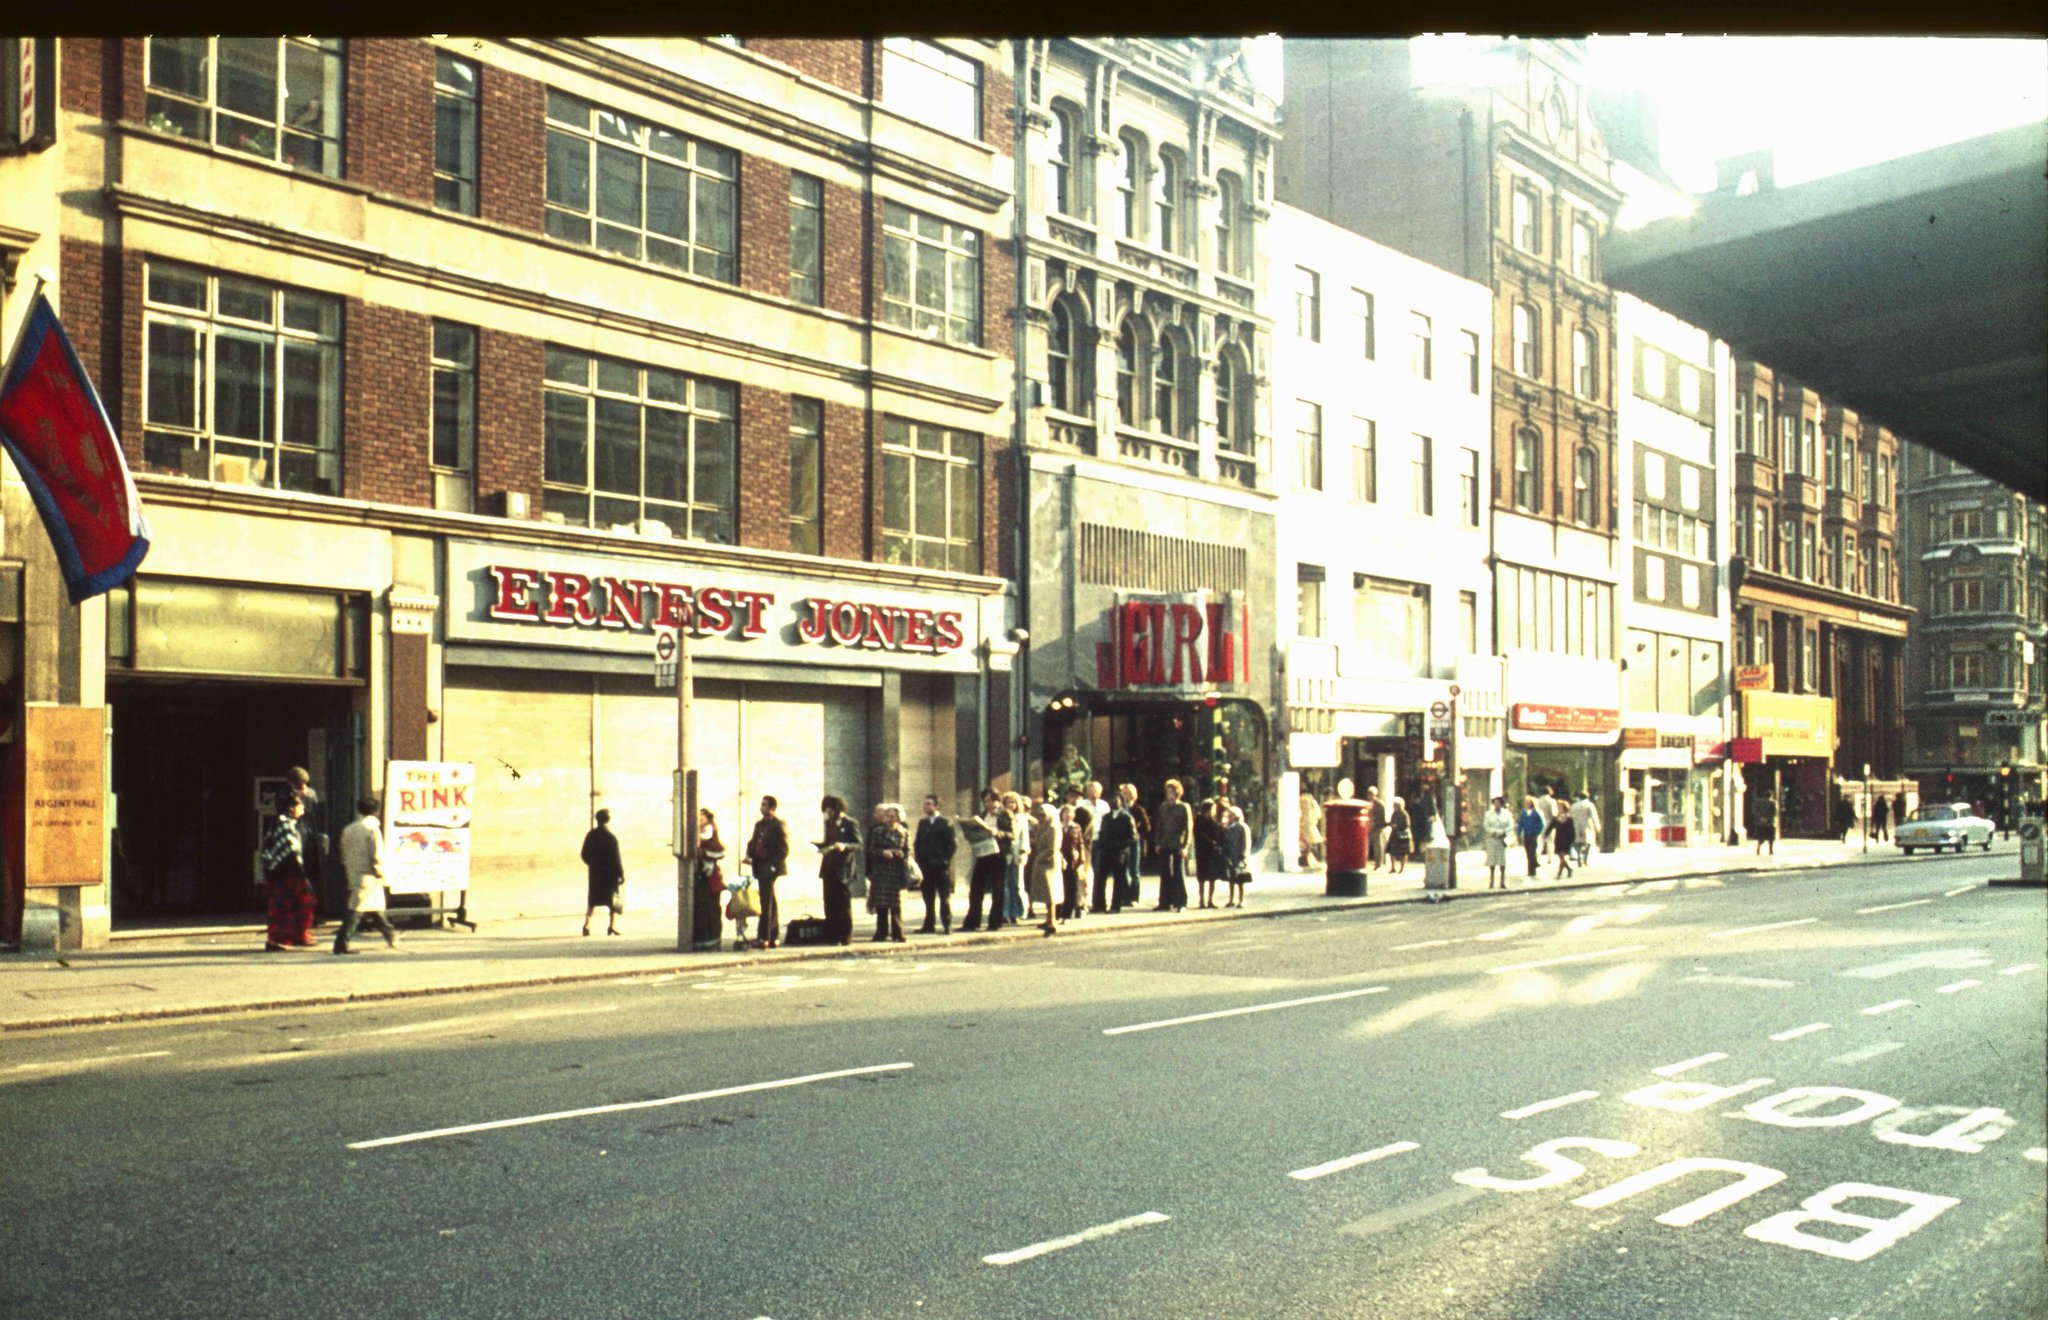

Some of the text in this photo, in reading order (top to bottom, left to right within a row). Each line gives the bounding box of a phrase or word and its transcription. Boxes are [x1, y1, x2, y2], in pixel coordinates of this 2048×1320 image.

[490, 564, 965, 654] ERNEST JONES
[400, 785, 467, 812] RINK
[1452, 1136, 1962, 1263] BUS
